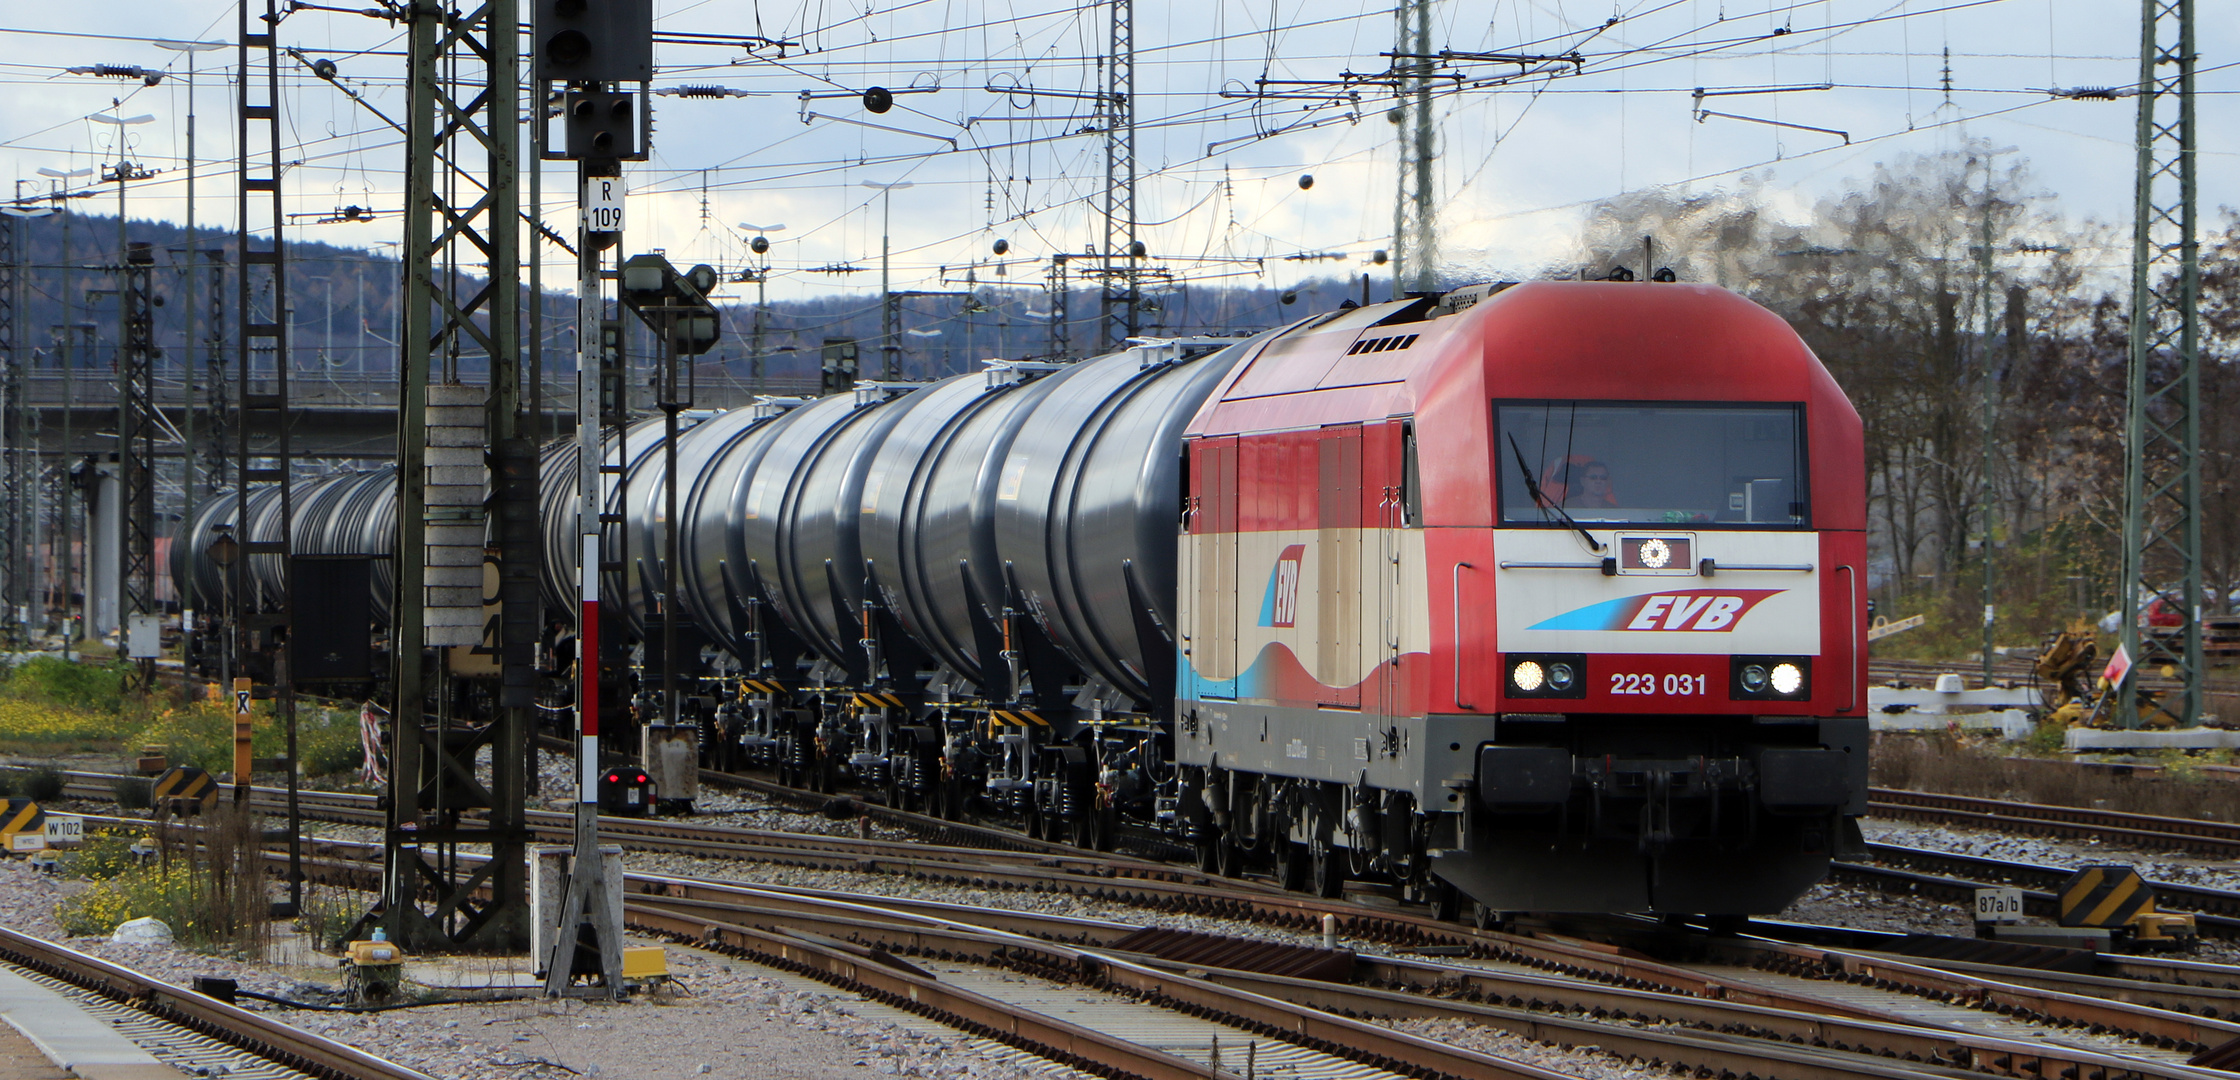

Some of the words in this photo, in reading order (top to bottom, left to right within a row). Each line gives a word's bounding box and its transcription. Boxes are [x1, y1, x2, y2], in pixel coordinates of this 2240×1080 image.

[602, 181, 611, 201] R
[593, 207, 621, 227] 109
[1275, 560, 1298, 623] EVB
[1627, 595, 1744, 630] EVB
[1610, 673, 1656, 695] 223
[1663, 673, 1706, 695] 031
[48, 822, 58, 836] W
[62, 822, 80, 836] 102
[1980, 896, 2018, 913] 87a/b
